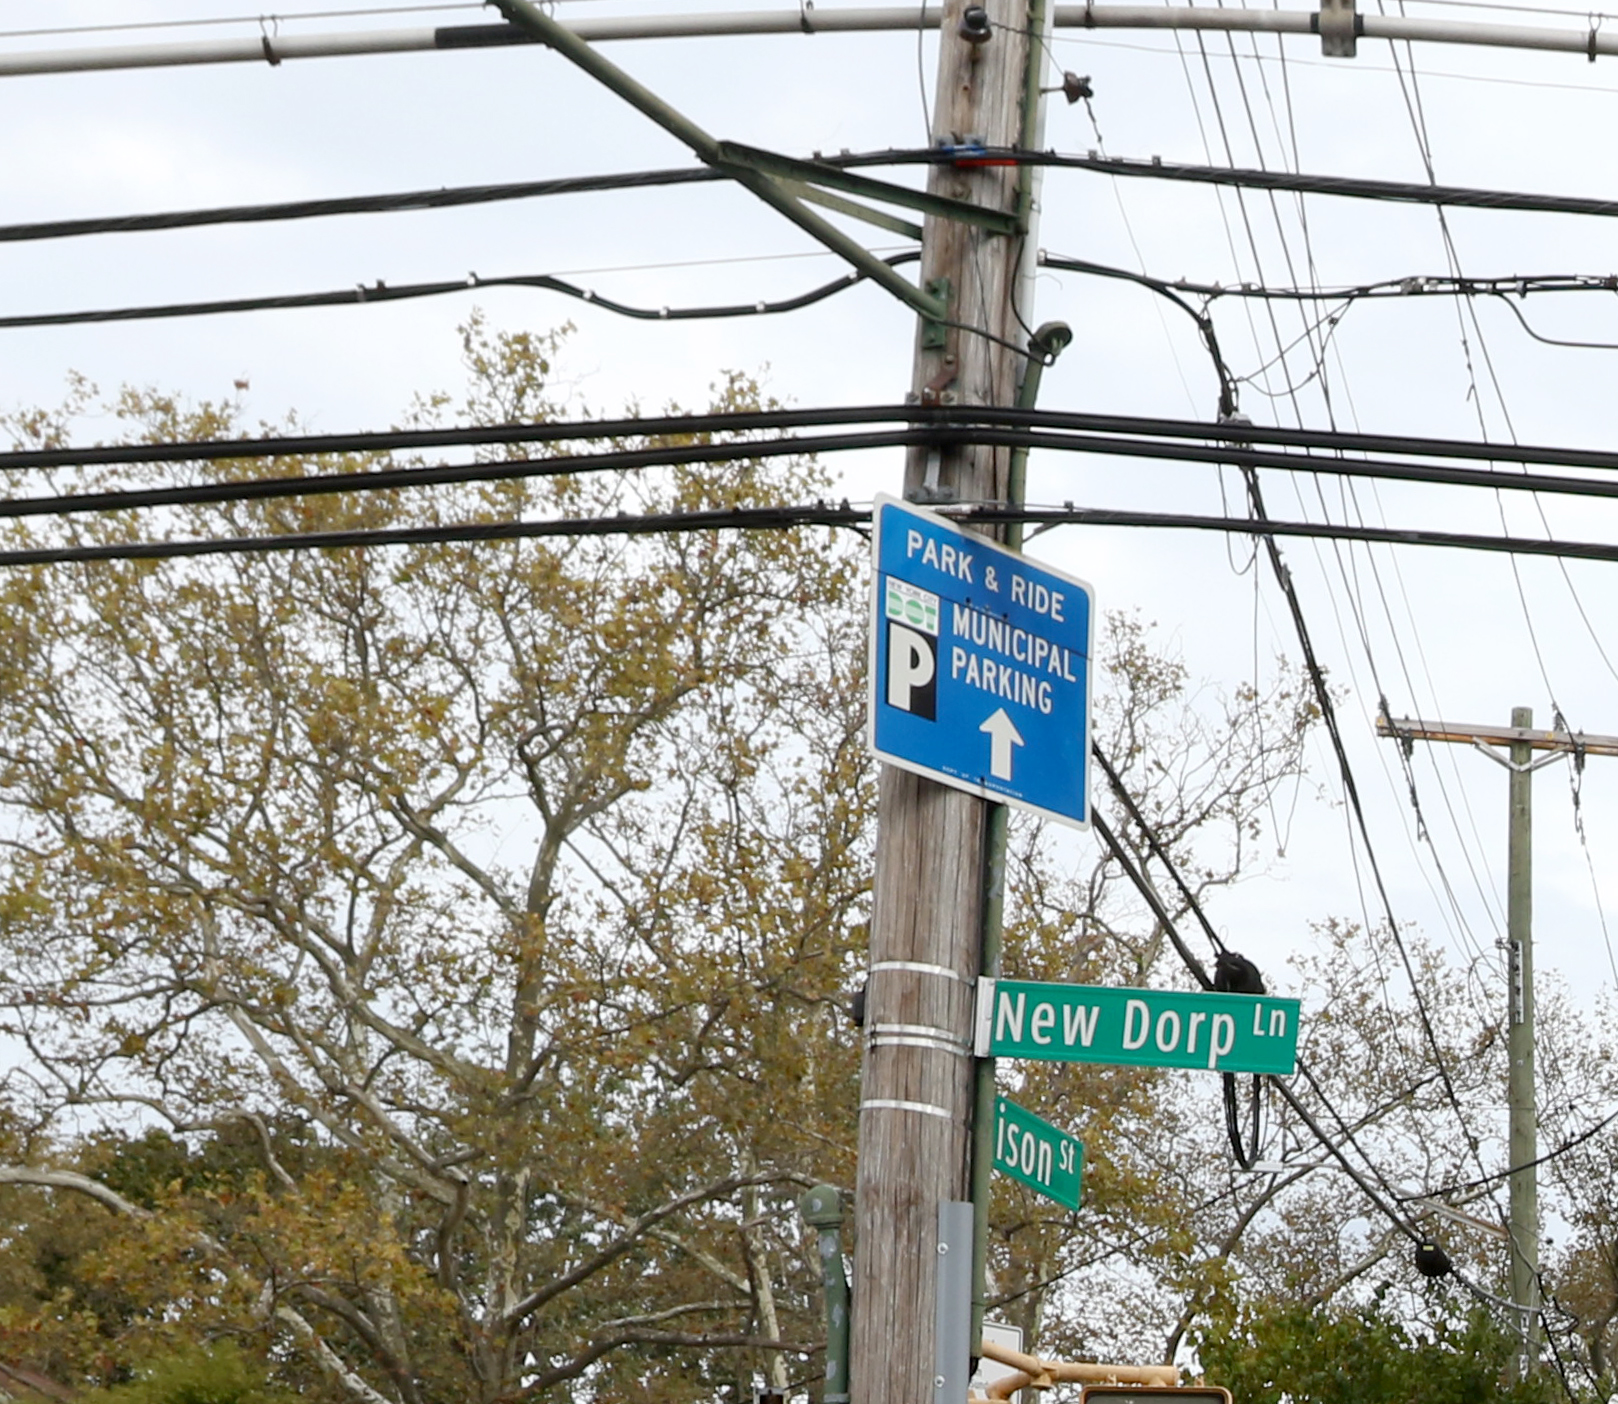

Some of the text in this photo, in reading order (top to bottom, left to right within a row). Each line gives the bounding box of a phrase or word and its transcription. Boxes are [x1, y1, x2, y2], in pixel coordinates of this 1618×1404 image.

[907, 528, 1065, 623] PARK & RIDE
[951, 646, 1052, 715] PARKING
[952, 602, 1077, 683] MUNICIPAL
[995, 991, 1287, 1069] New Dorp Ln
[996, 1102, 1075, 1186] ison St
